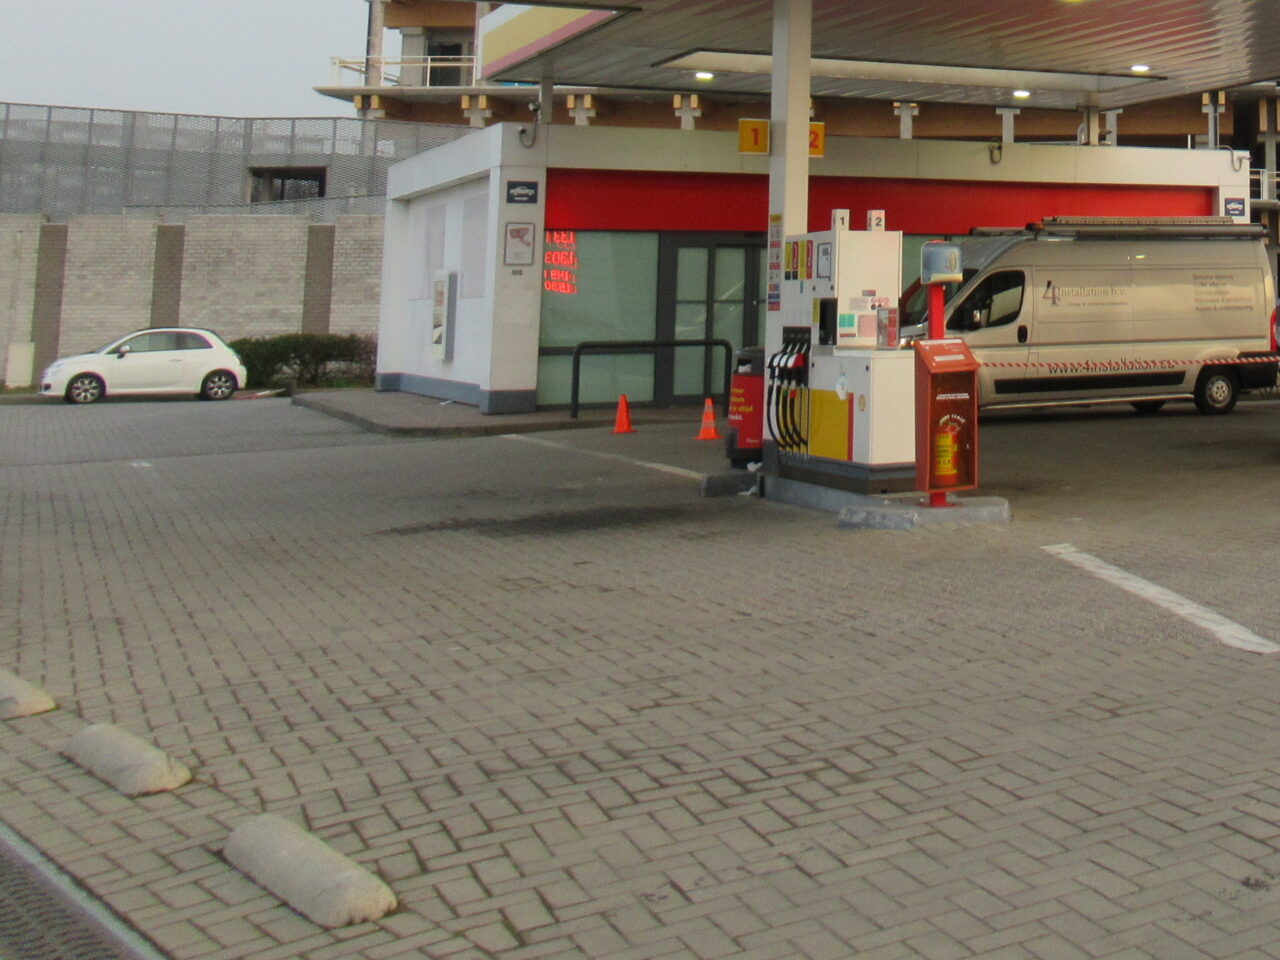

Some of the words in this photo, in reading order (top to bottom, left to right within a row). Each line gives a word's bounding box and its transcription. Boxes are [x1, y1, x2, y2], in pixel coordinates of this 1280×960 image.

[751, 127, 760, 146] 1
[809, 130, 819, 149] 2
[840, 216, 845, 226] 1
[875, 217, 882, 227] 2
